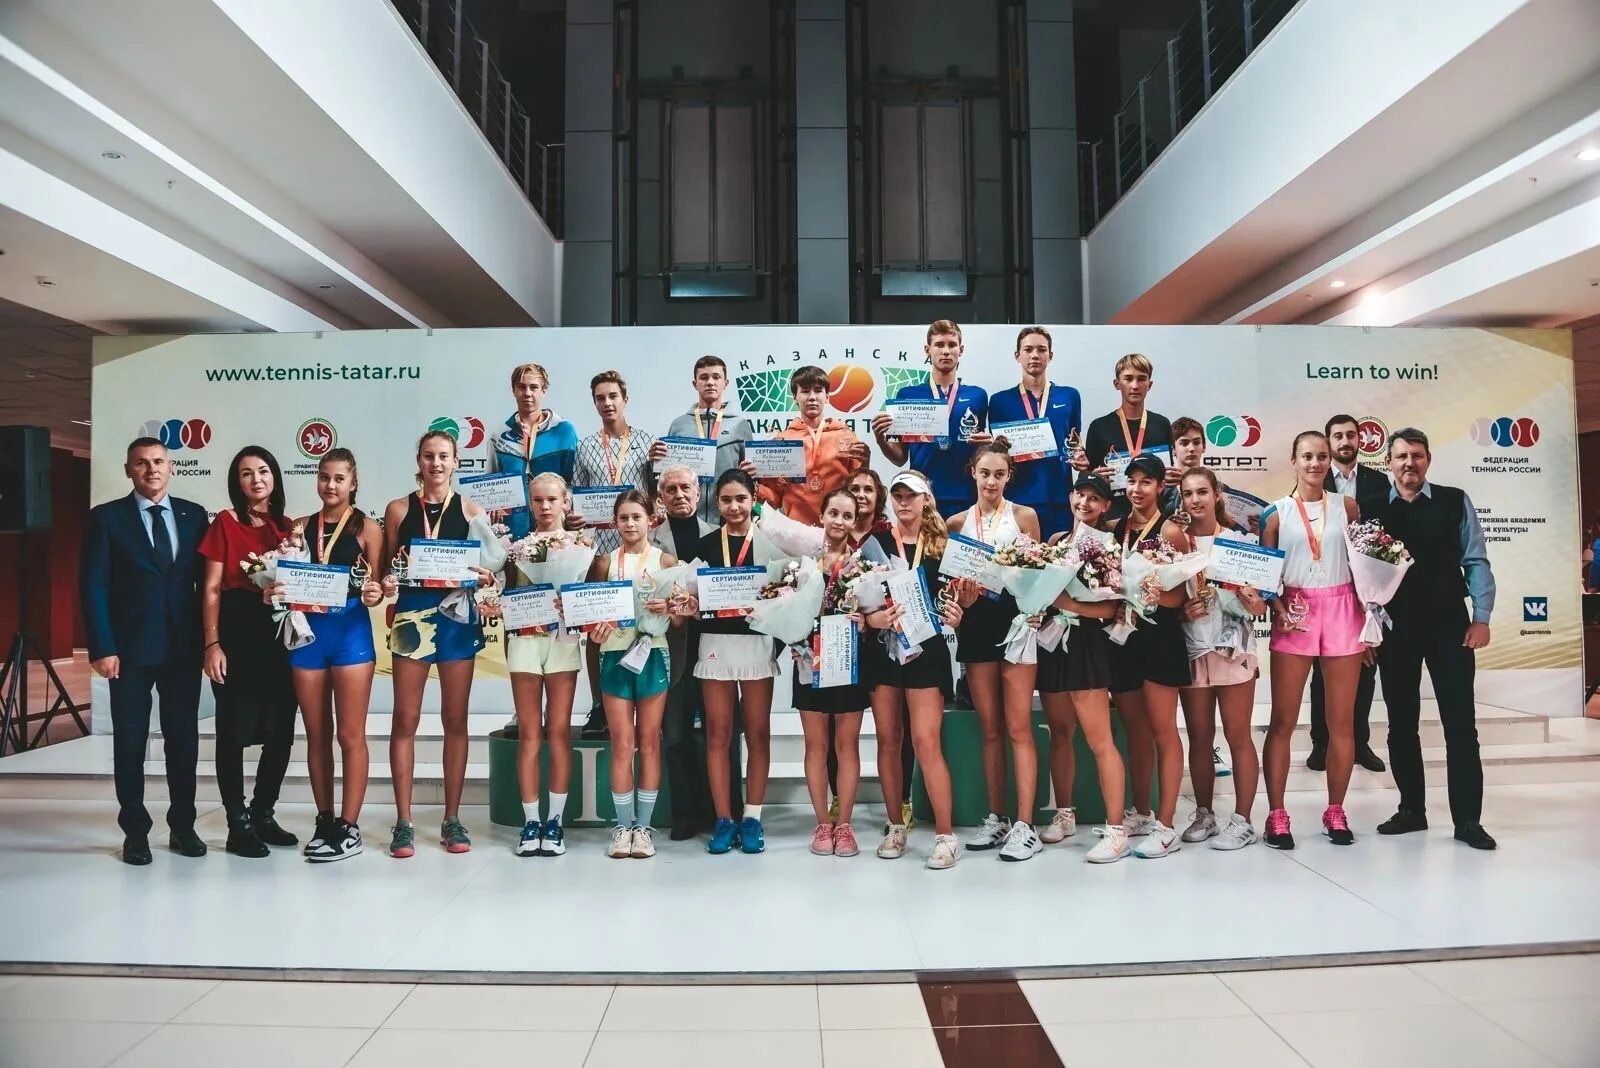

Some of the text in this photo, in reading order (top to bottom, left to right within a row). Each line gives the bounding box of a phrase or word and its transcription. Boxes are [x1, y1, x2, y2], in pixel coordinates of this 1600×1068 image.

[739, 348, 960, 371] КАЗАНСКА
[206, 363, 420, 381] www.tennis-tatar.ru
[1306, 363, 1438, 380] Learn to win!
[667, 444, 704, 452] СЕРТИФИКАТ
[170, 459, 198, 467] РАЦИЯ
[458, 459, 487, 469] РТ
[1203, 456, 1267, 467] ФТРТ
[472, 479, 510, 489] СЕРТИФИКАТ
[423, 547, 467, 555] СЕРТИФИКАТ
[1225, 549, 1270, 563] СЕРТИФИКАТ
[290, 570, 335, 579] СЕРТИФИКАТ
[711, 575, 755, 583] СЕРТИФИКАТ
[510, 592, 546, 602] СЕРТИФИКАТ
[575, 589, 619, 598] СЕРТИФИКАТ
